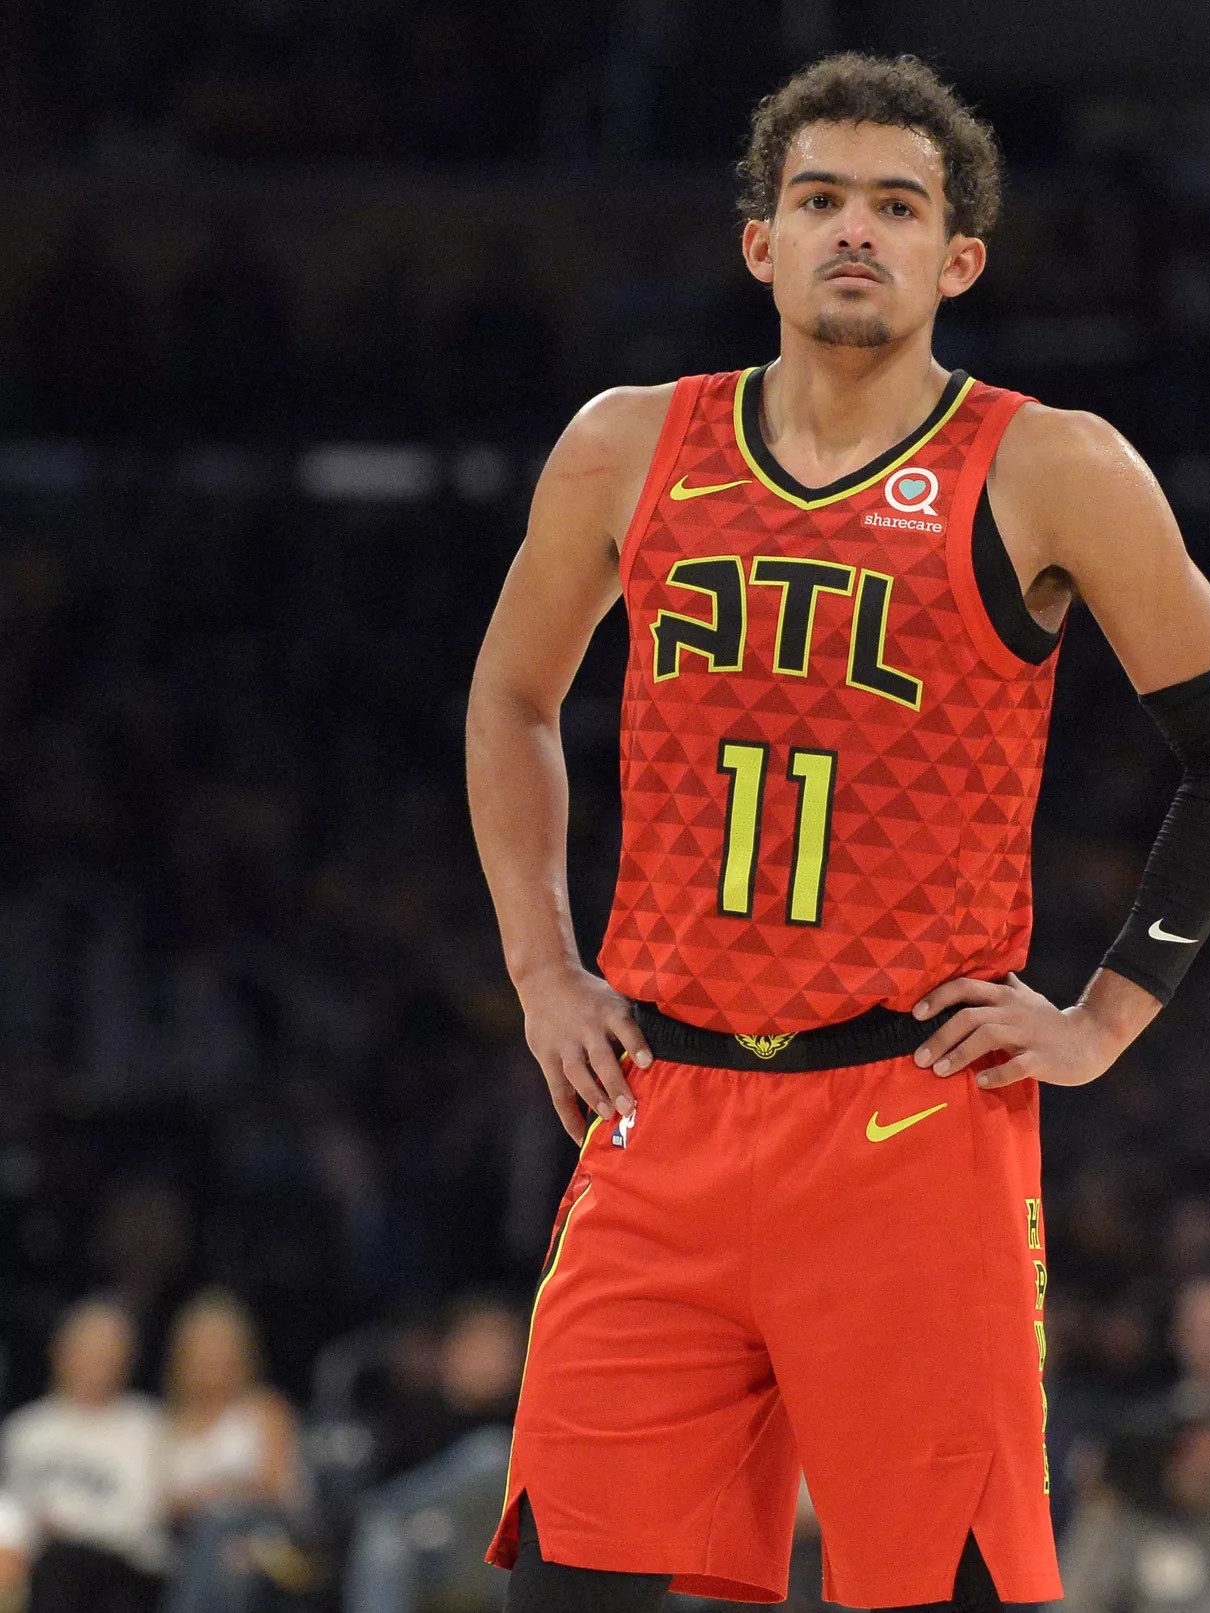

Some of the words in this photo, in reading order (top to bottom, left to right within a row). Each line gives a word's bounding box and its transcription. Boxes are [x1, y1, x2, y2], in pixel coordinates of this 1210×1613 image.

[864, 512, 943, 534] sharecare
[649, 554, 924, 712] ATL
[716, 737, 839, 928] 11
